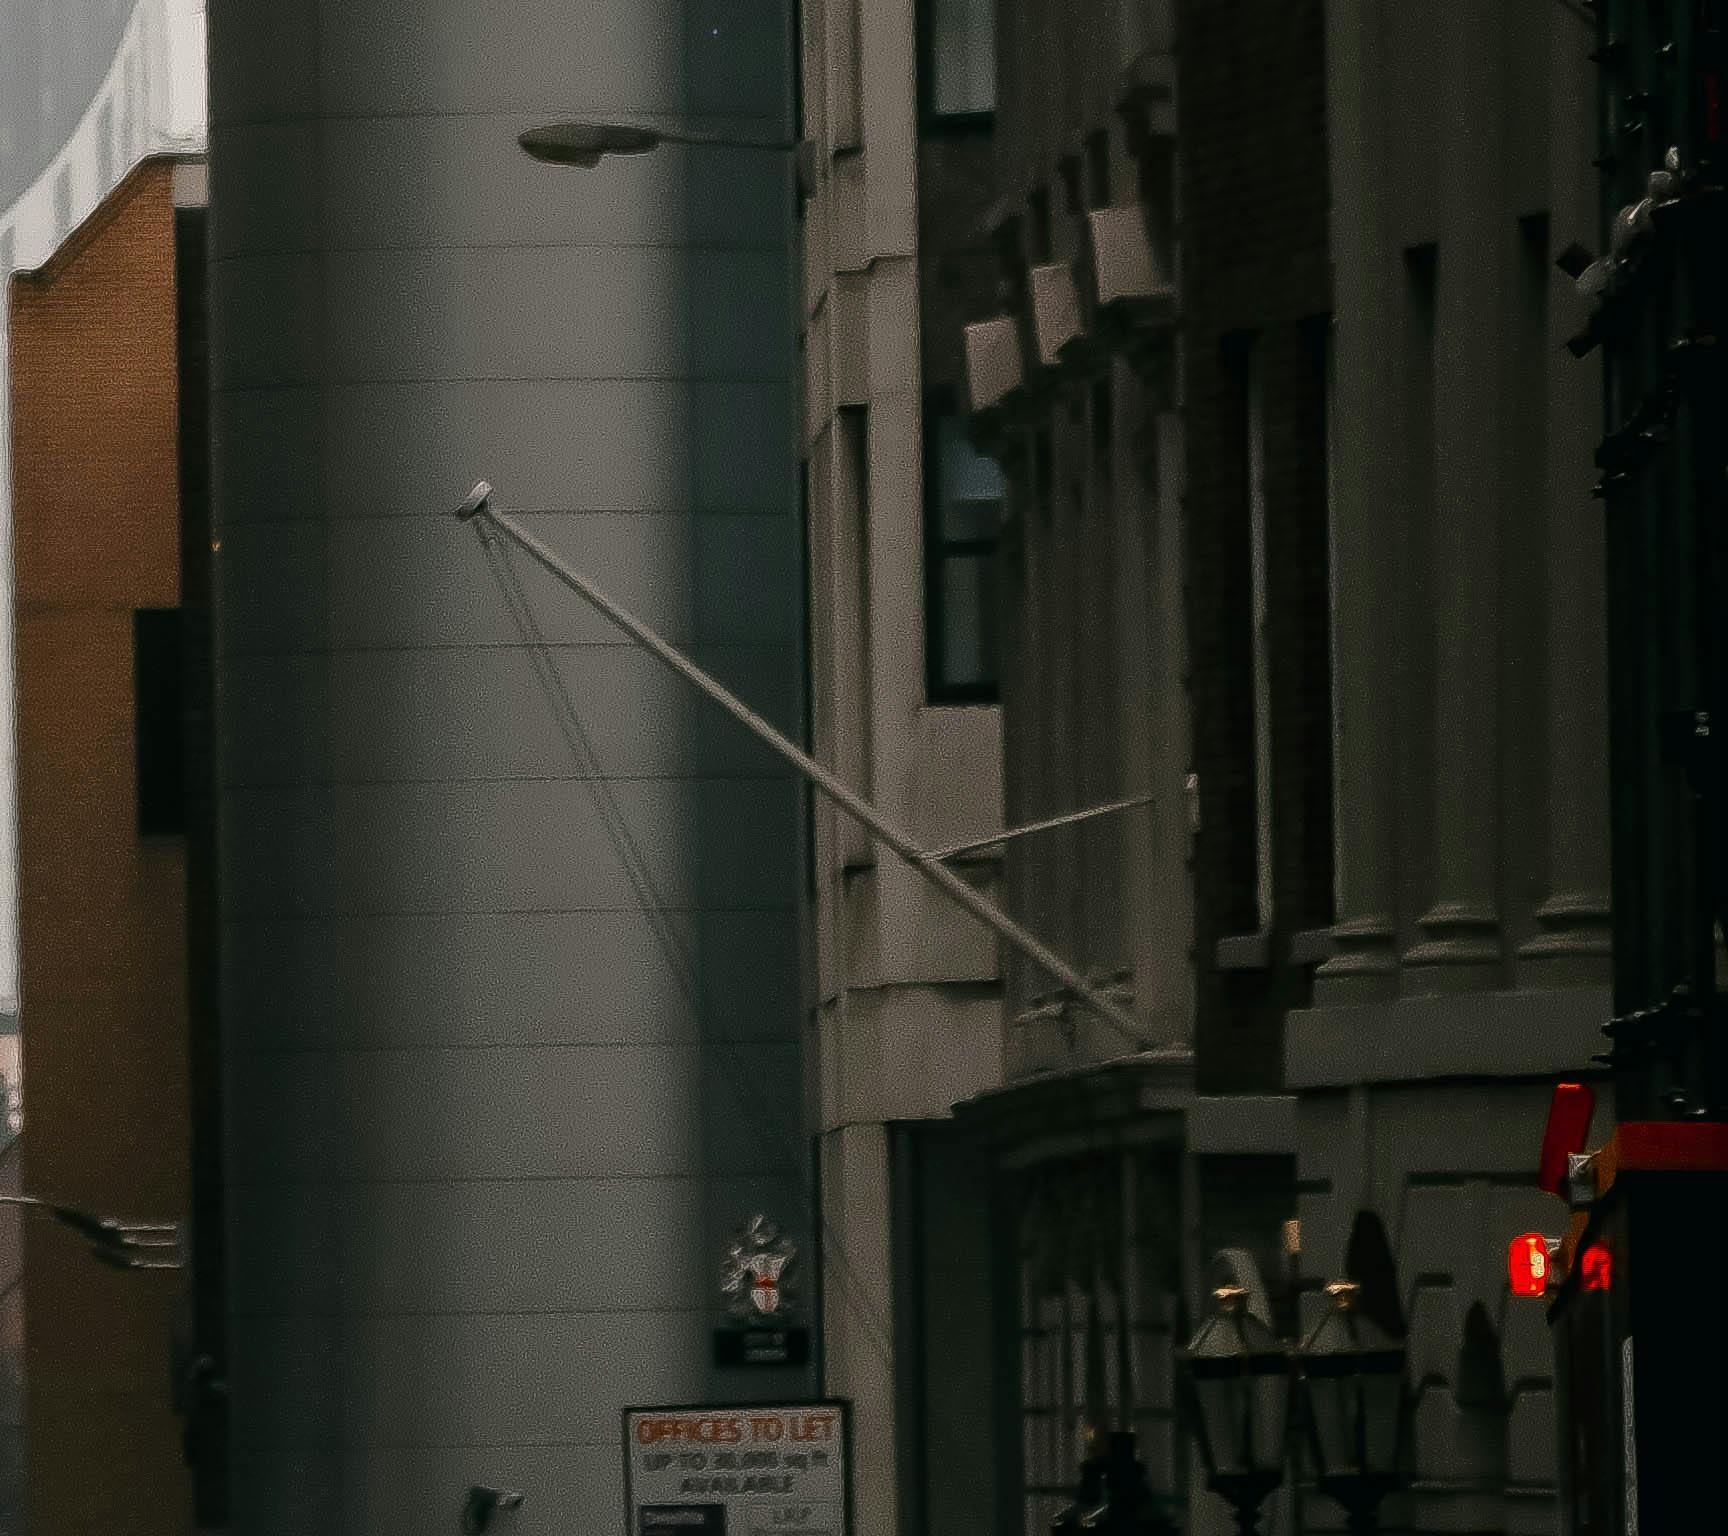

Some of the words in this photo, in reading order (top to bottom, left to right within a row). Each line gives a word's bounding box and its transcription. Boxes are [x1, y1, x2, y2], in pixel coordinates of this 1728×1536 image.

[638, 1417, 741, 1444] OFFICES
[751, 1417, 784, 1442] TO
[790, 1415, 834, 1441] LET
